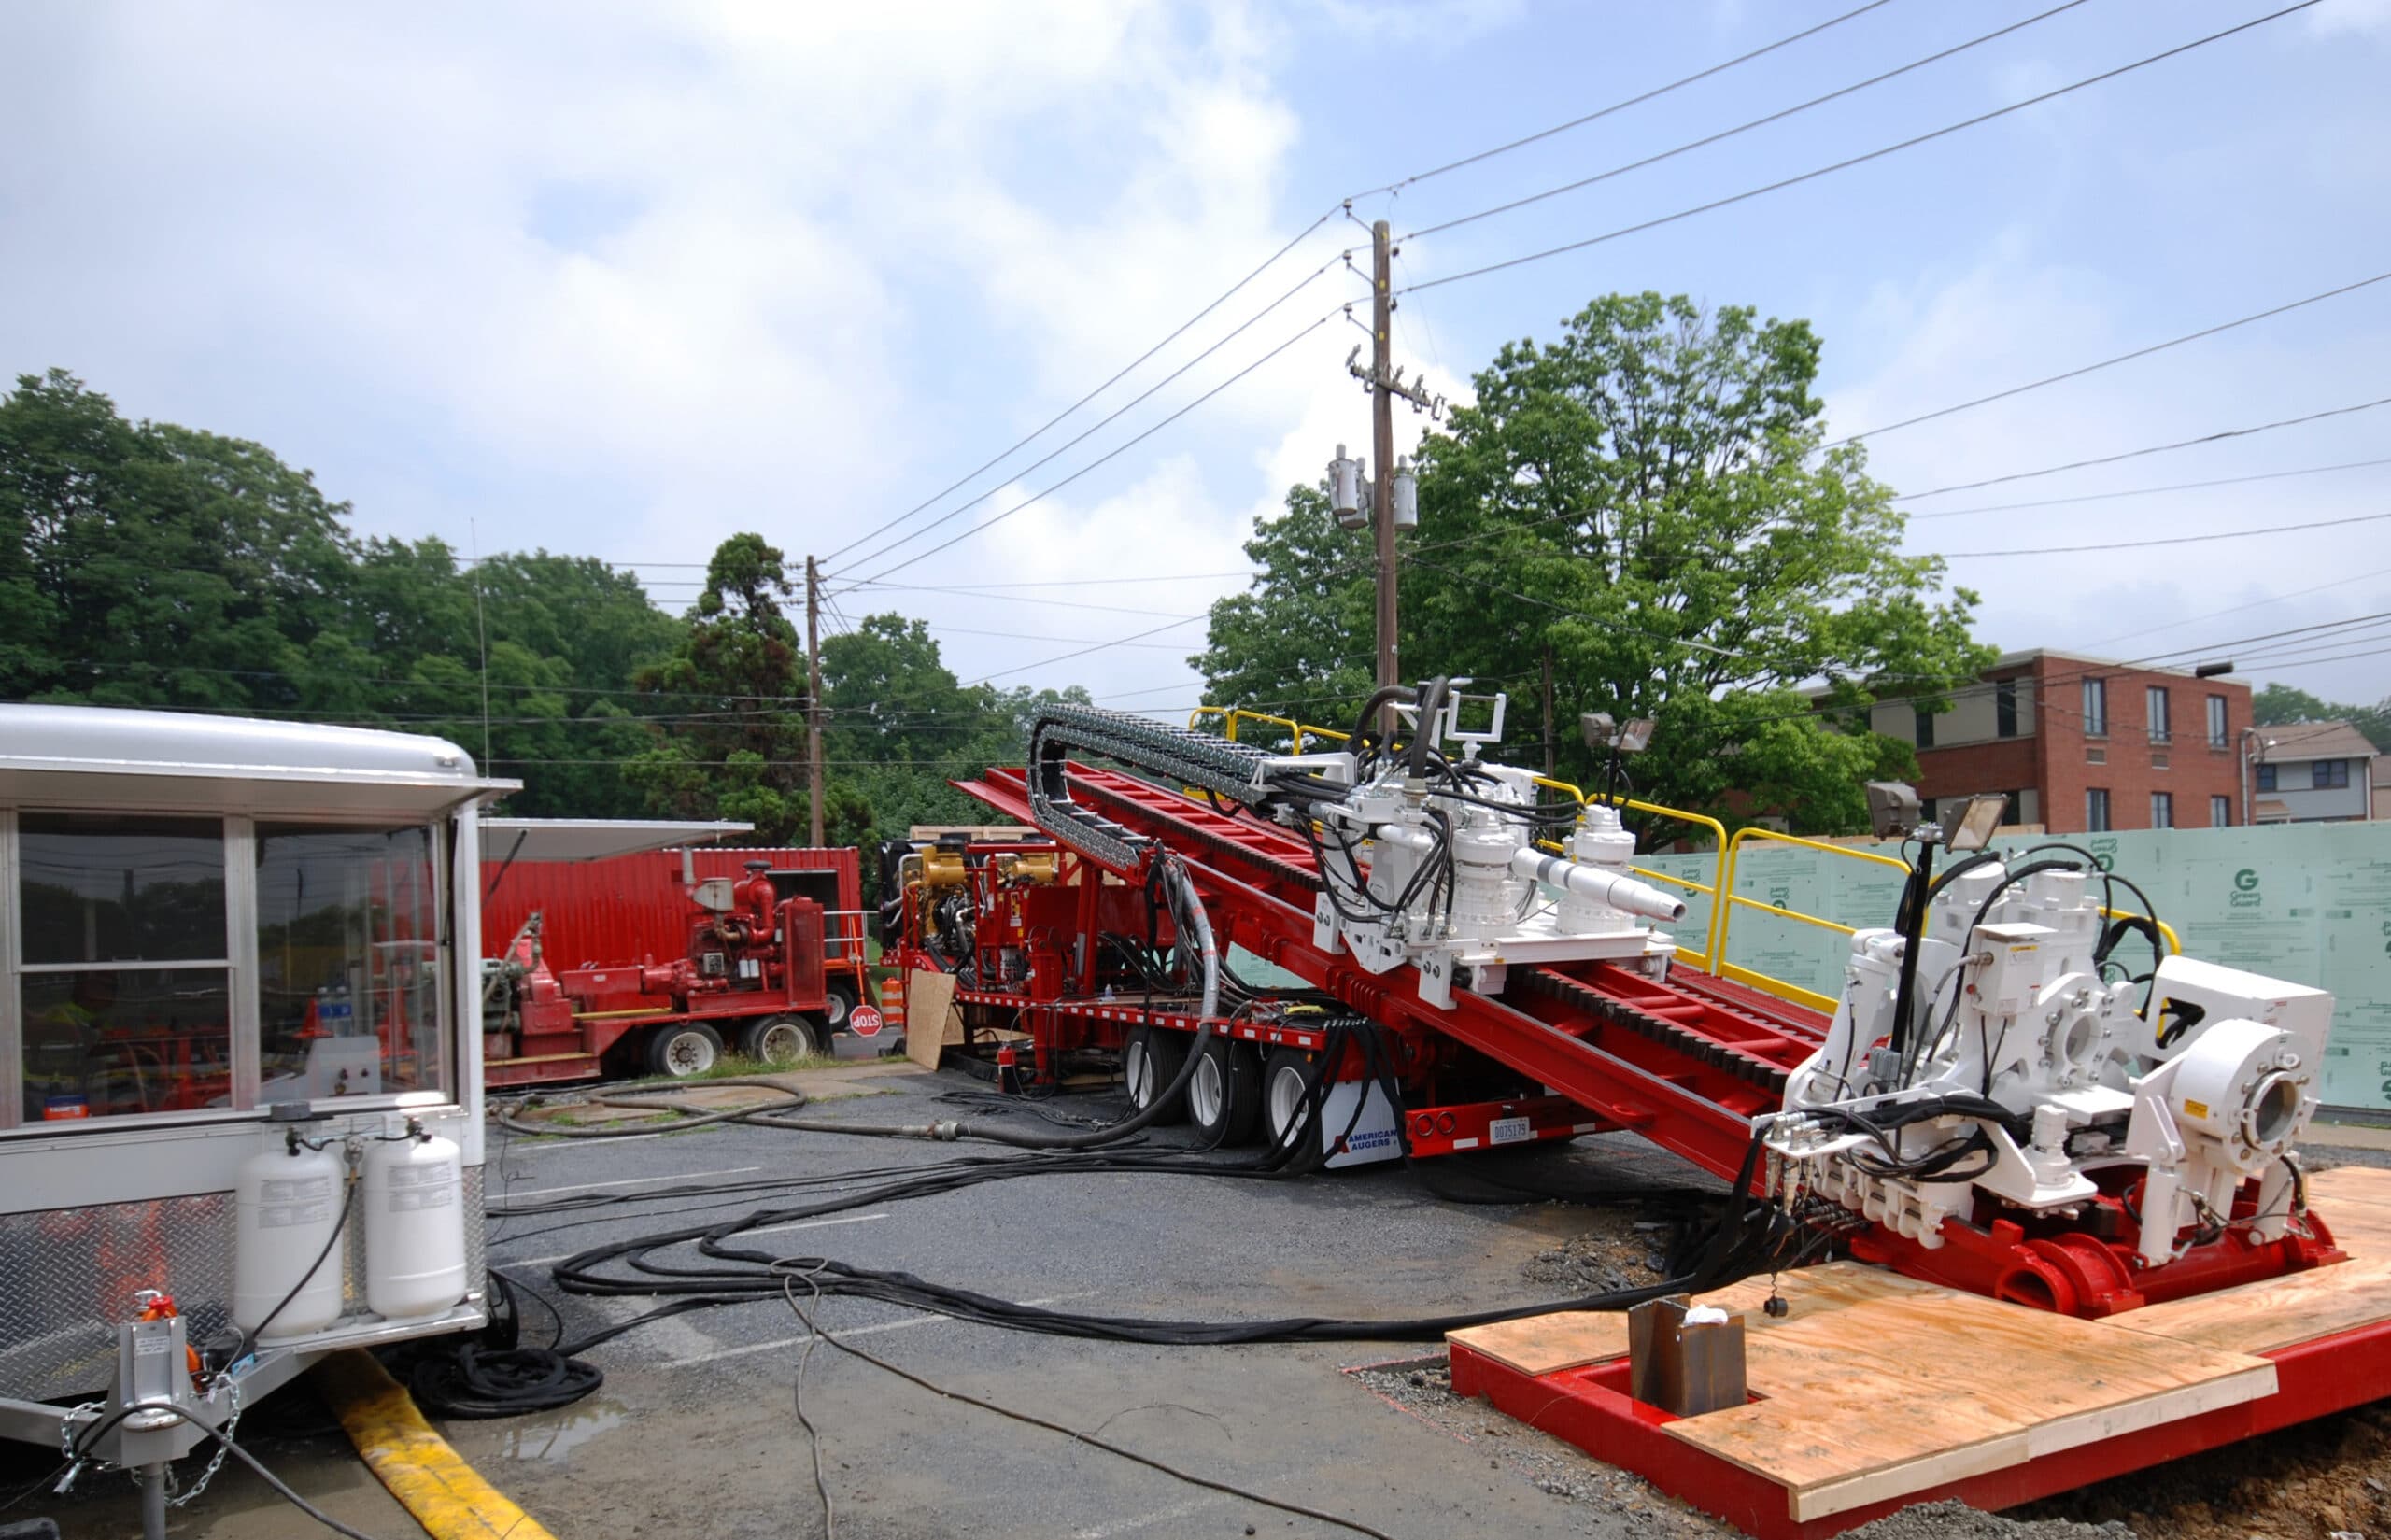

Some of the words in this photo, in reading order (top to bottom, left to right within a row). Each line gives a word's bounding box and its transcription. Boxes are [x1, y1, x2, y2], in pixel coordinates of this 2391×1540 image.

[2235, 869, 2258, 891] G
[2230, 890, 2260, 899] Green
[2230, 898, 2261, 908] Guard
[853, 1014, 879, 1027] STOP
[1348, 1128, 1398, 1143] AMERICAN
[1351, 1138, 1391, 1151] AUGERS
